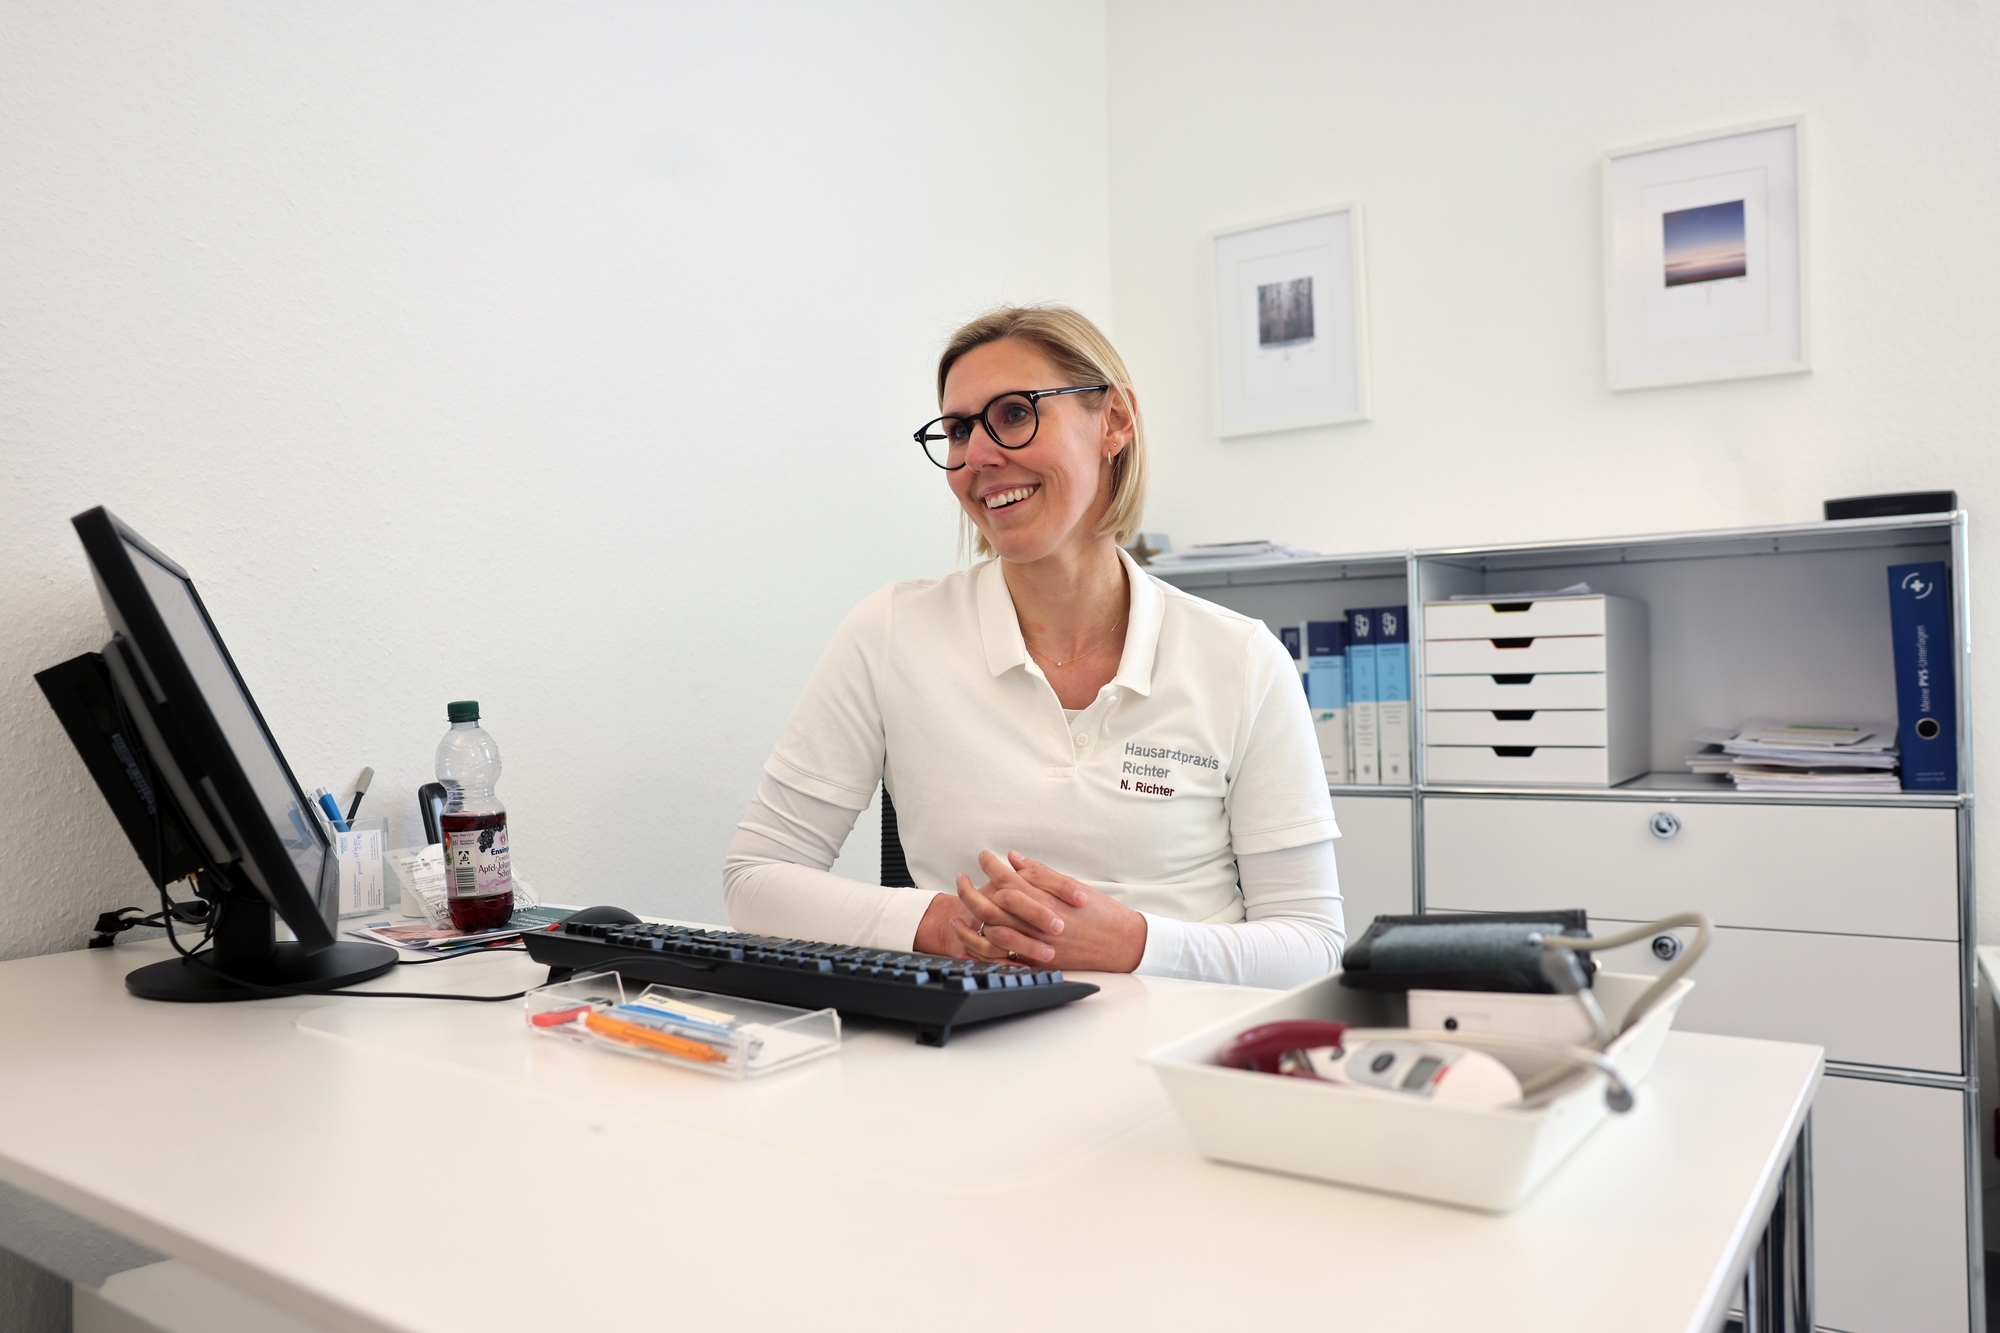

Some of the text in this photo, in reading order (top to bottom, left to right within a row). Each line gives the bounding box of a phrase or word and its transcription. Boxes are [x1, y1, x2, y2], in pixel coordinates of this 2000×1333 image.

[1920, 687, 1931, 712] Meine
[1125, 742, 1219, 770] Hausarztpraxis
[1122, 761, 1171, 778] Richter
[1120, 779, 1175, 797] N. Richter
